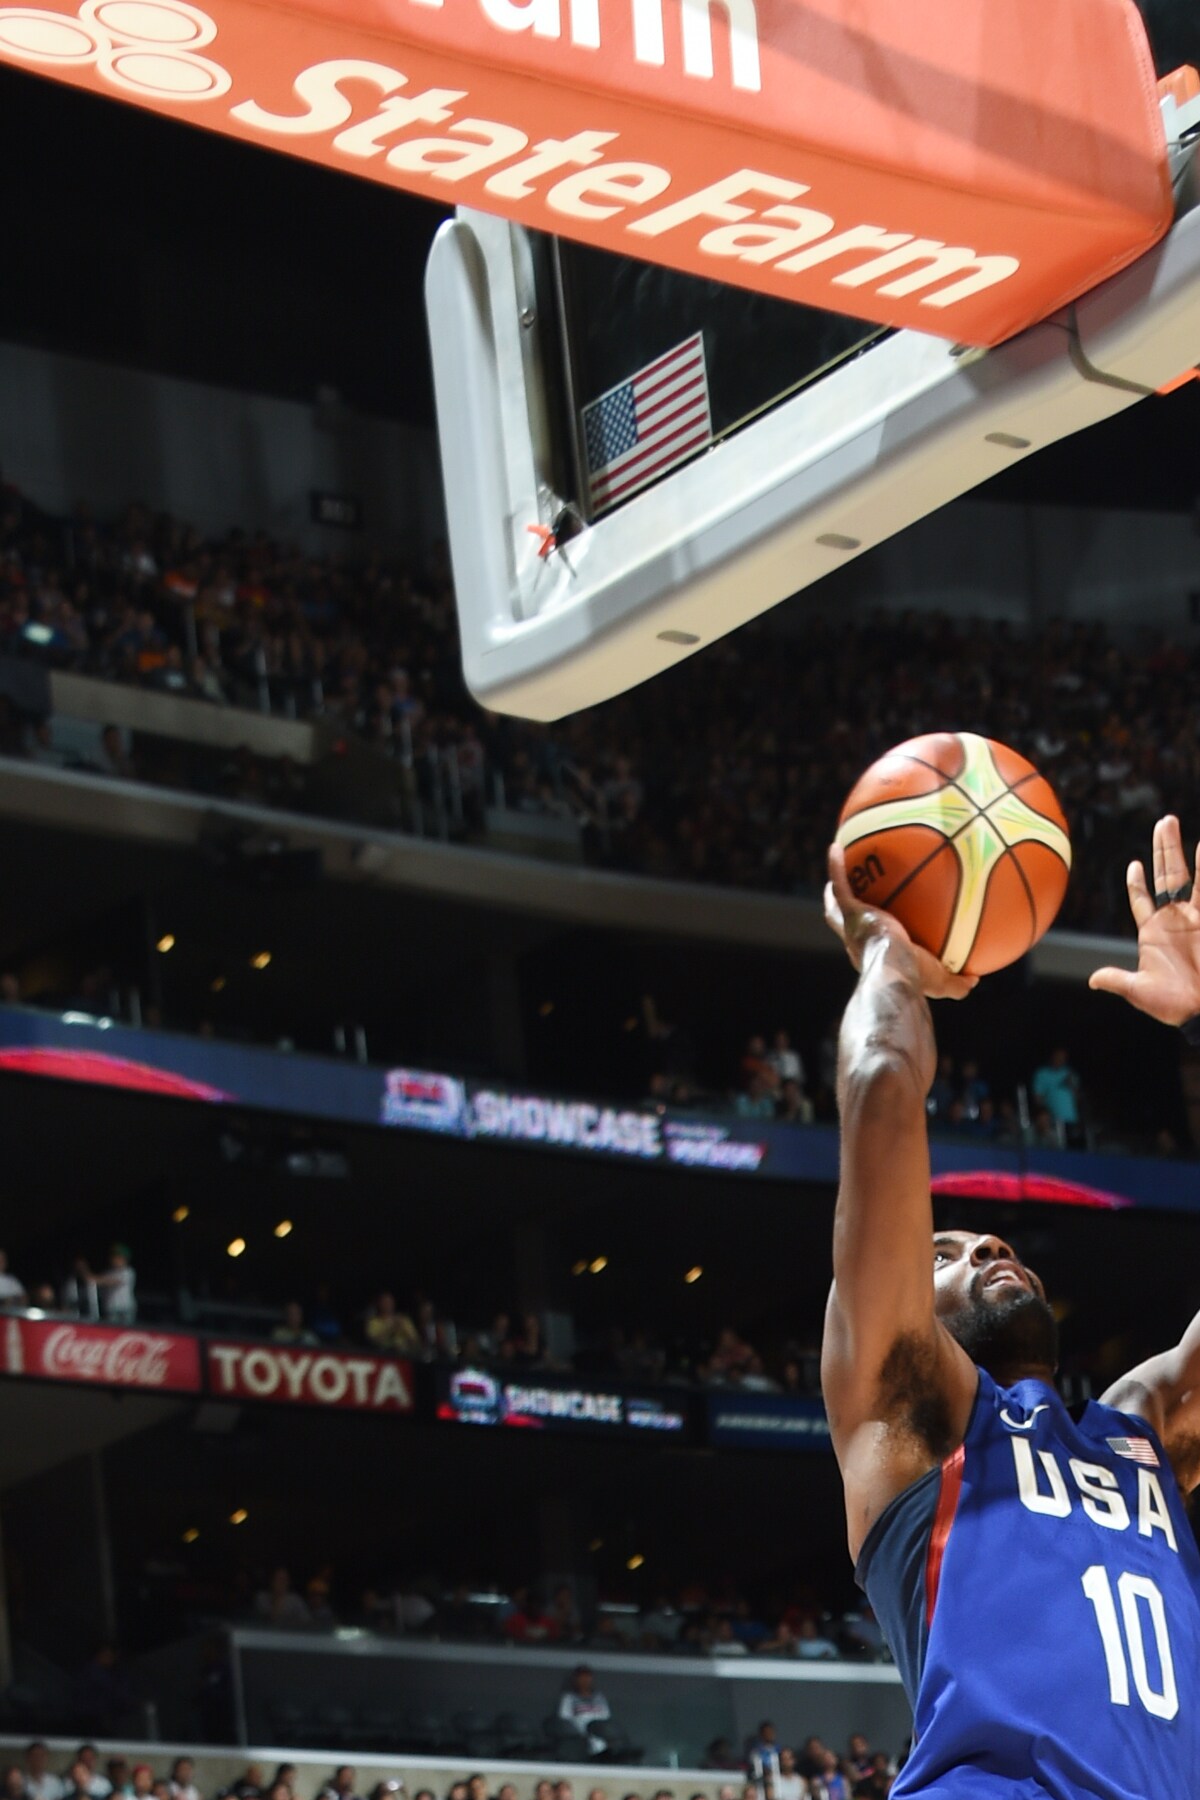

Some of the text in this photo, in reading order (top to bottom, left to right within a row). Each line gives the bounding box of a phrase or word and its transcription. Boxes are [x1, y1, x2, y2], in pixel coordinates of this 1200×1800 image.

[472, 1091, 664, 1158] SHOWCASE
[209, 1345, 411, 1406] TOYOTA
[1011, 1436, 1179, 1554] USA
[1081, 1564, 1180, 1722] 10
